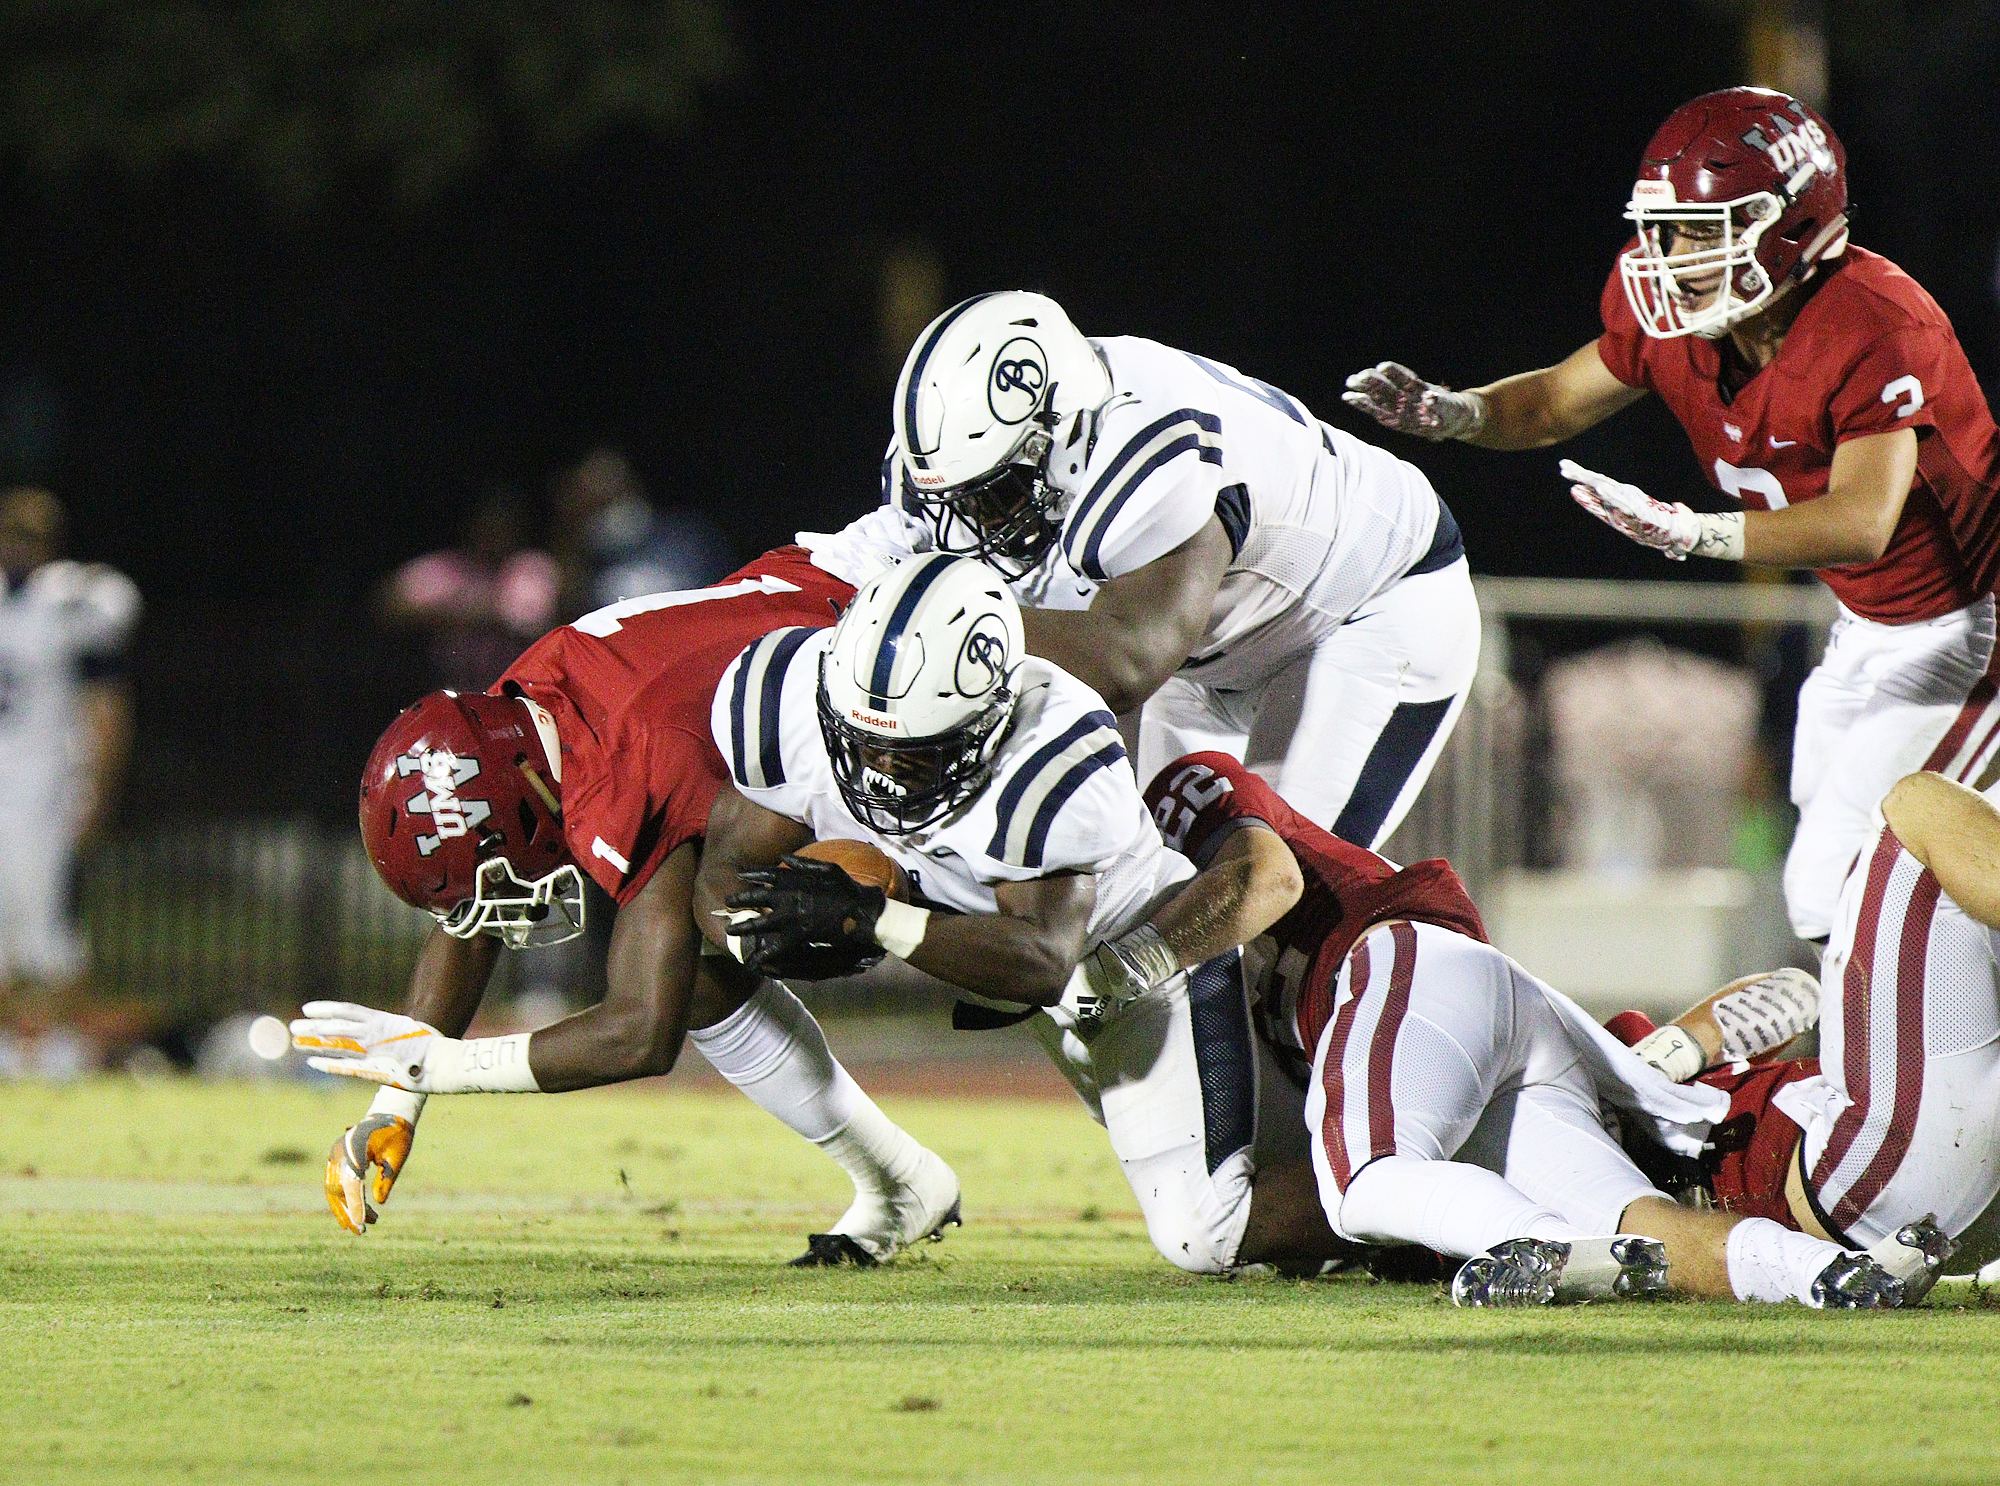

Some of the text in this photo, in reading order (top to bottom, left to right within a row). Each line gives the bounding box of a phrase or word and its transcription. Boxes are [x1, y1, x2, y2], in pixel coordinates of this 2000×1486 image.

[1766, 119, 1827, 173] UMS
[852, 709, 897, 730] Riddell
[419, 751, 468, 840] UMS
[1153, 764, 1235, 852] 22
[591, 835, 630, 874] 1
